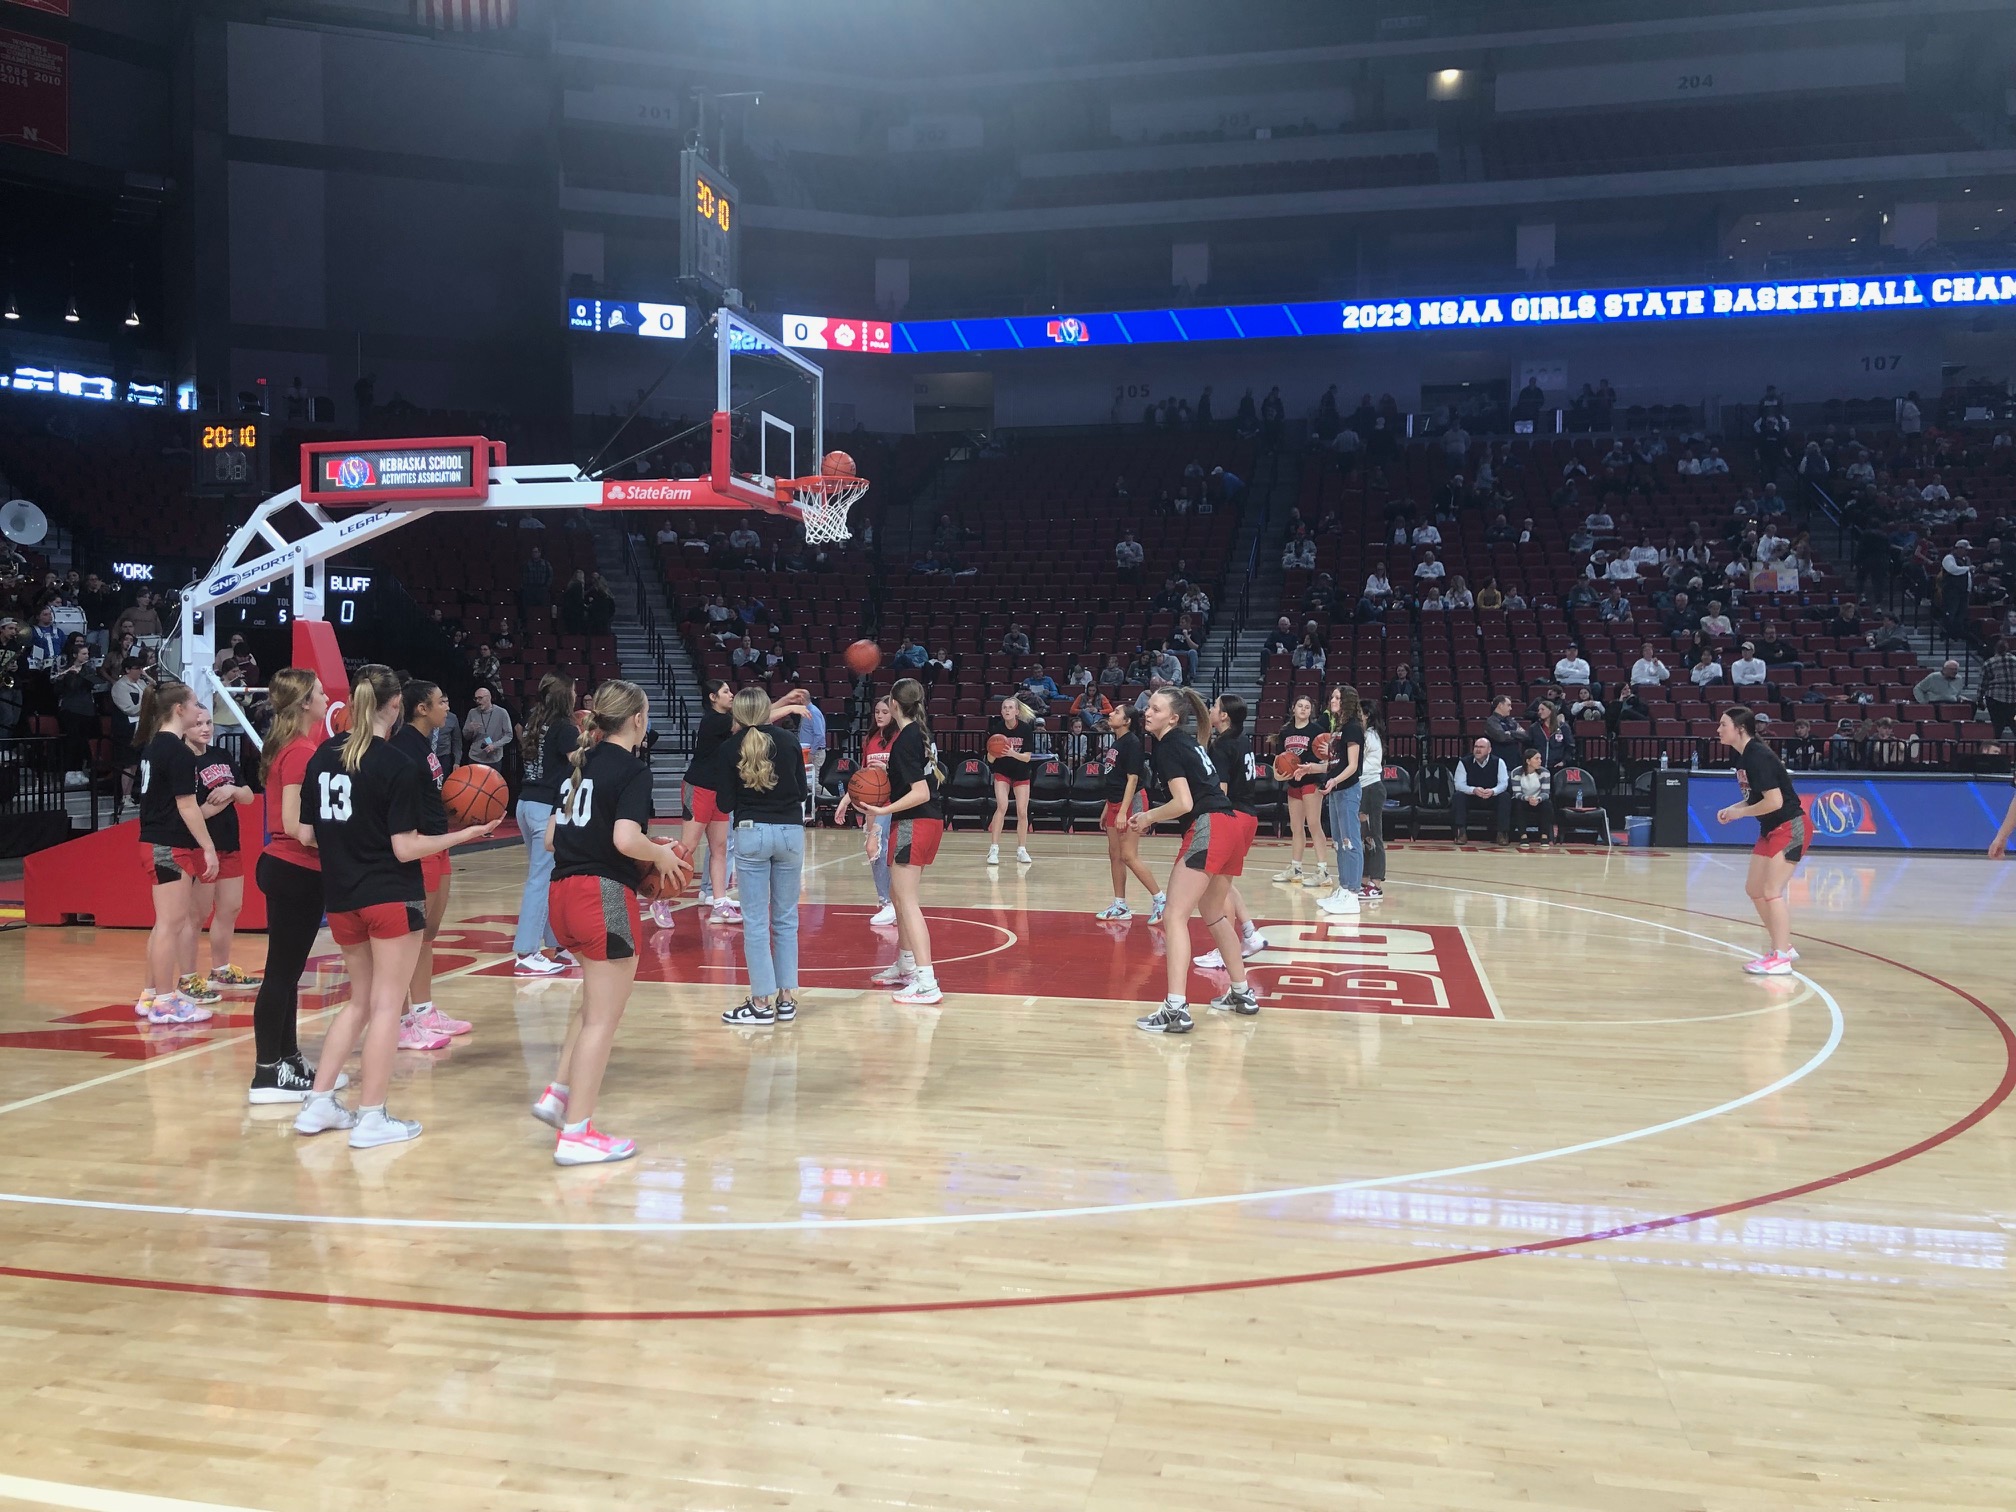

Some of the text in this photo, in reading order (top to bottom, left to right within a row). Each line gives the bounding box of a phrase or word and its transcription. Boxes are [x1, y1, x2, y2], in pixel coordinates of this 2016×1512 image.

[34, 72, 61, 86] 2010
[1678, 74, 1713, 90] 204
[637, 104, 671, 120] 201
[576, 304, 587, 318] 0
[1342, 304, 1412, 329] 2023
[1419, 299, 1503, 326] NSAA
[1511, 295, 1596, 321] GIRLS
[1604, 290, 1705, 317] STATE
[1714, 280, 1923, 313] BASKETBALL
[660, 312, 673, 331] 0
[795, 323, 808, 341] 0
[875, 327, 884, 341] 0
[1861, 355, 1903, 371] 107
[1115, 384, 1150, 399] 105
[203, 424, 256, 449] 20:10
[379, 454, 464, 472] NEBRASKA SCHOOL
[381, 470, 461, 485] ACTIVITIES ASSOCIATION
[339, 508, 392, 537] LEGACY
[113, 562, 154, 580] YORK
[209, 576, 240, 593] SNA
[241, 552, 295, 581] SPORTS
[330, 575, 371, 592] BLUFF
[228, 596, 257, 605] ERIOD
[277, 598, 290, 607] TOL
[341, 600, 355, 622] 0
[837, 759, 850, 771] N
[965, 761, 979, 773] N
[1046, 762, 1059, 774] N
[1086, 763, 1099, 775] N
[1383, 767, 1398, 779] N
[1566, 769, 1582, 782] N
[318, 771, 353, 821] 13
[556, 777, 594, 827] 30
